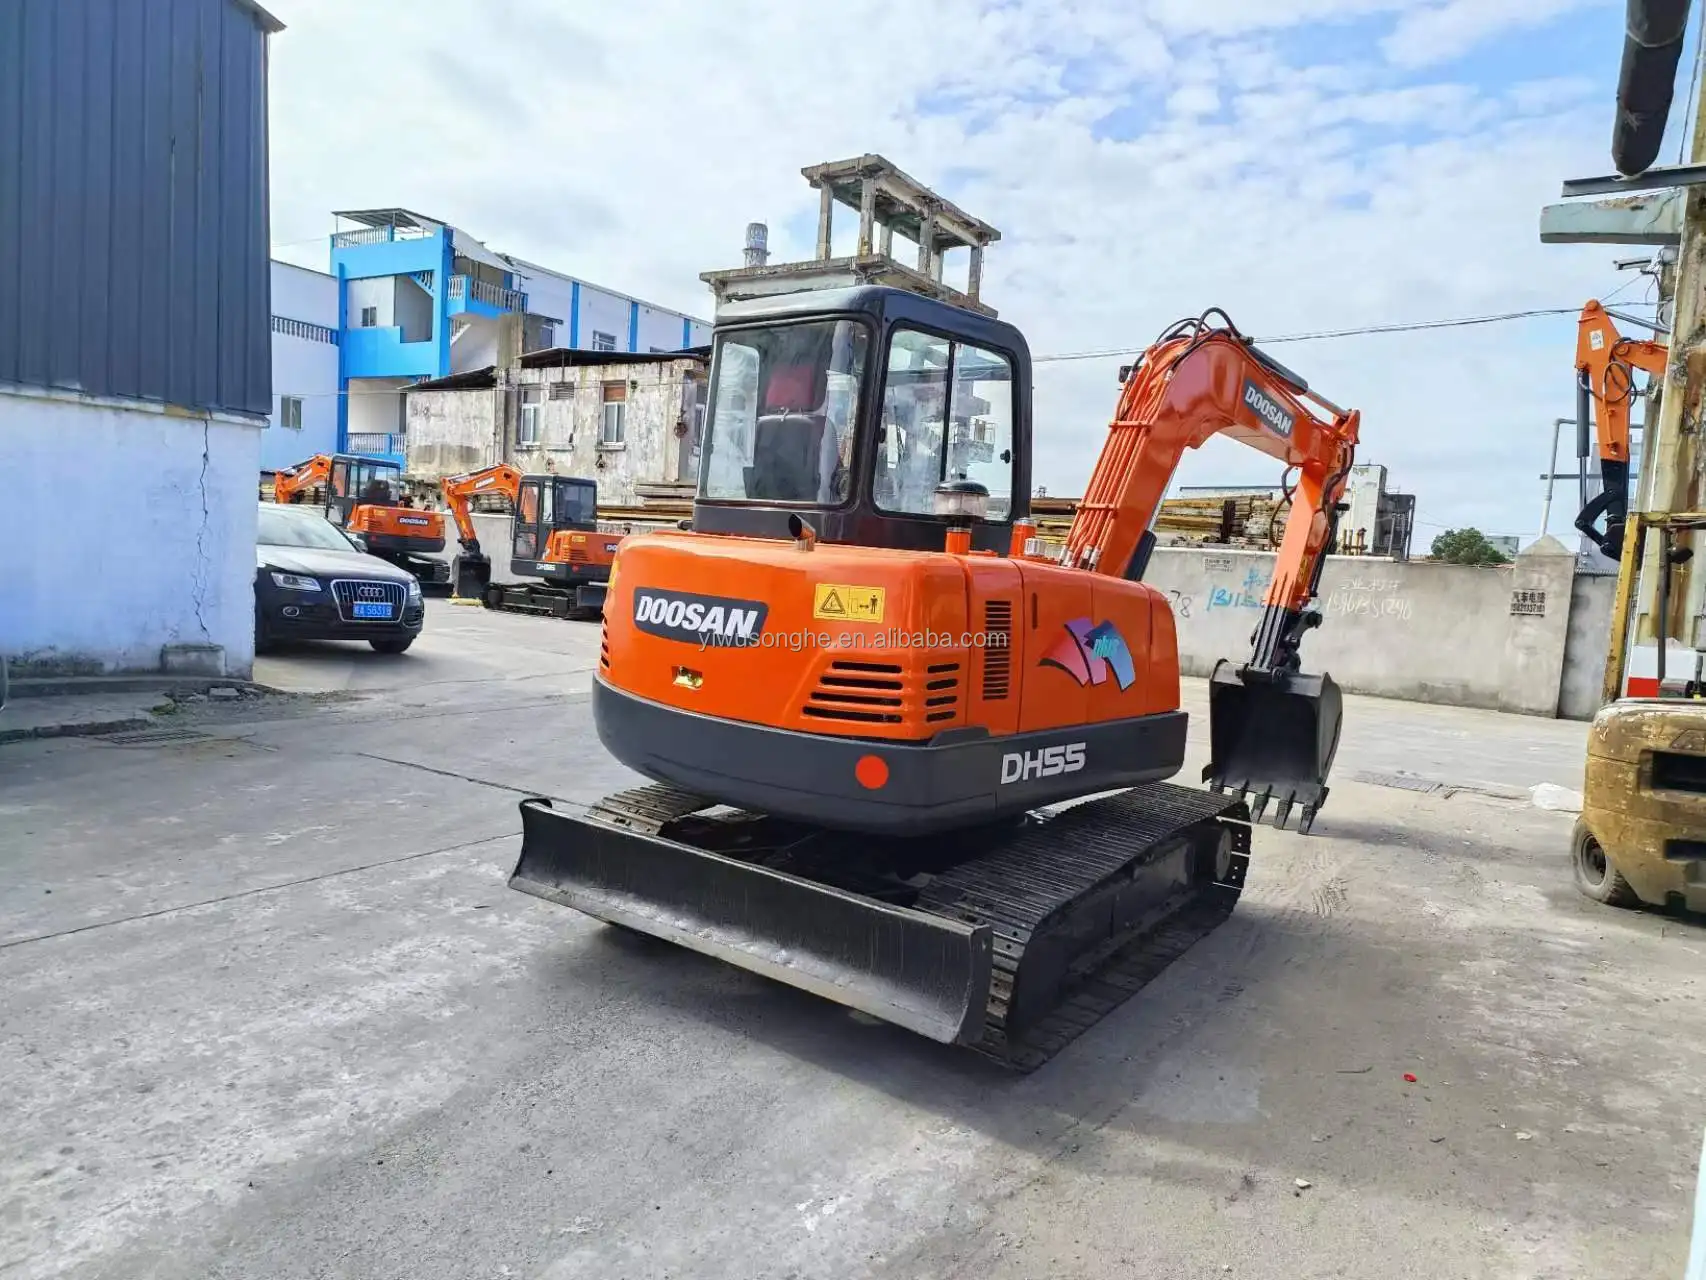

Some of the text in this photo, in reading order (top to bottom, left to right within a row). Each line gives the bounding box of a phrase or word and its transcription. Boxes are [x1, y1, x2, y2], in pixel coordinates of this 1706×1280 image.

[1244, 385, 1293, 435] DOOSAN
[635, 595, 759, 639] DOOSAN
[1000, 741, 1087, 786] DH55
